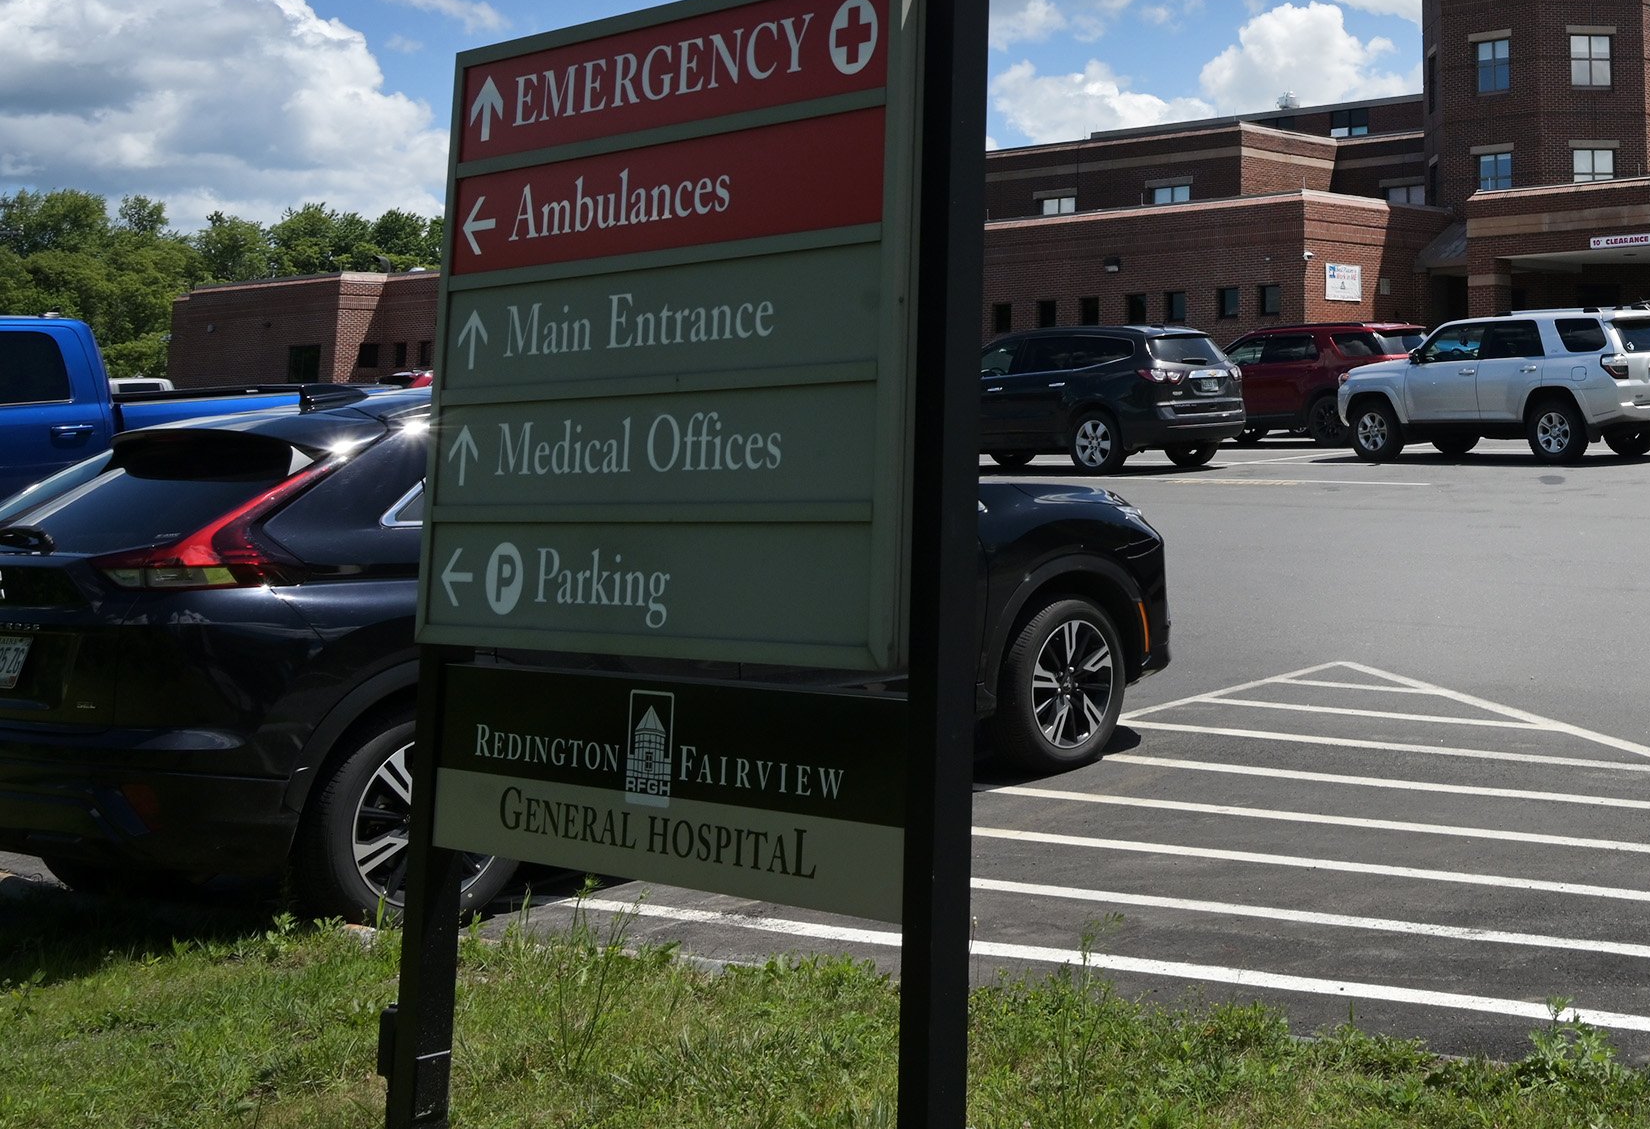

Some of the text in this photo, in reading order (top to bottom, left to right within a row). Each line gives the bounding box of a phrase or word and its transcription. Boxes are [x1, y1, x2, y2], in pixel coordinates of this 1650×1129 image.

[512, 13, 814, 127] EMERGENCY
[509, 168, 730, 241] Ambulances
[1606, 236, 1649, 245] CLEARANCE
[503, 292, 774, 358] Main Entrance
[494, 411, 782, 476] Medical Offices
[534, 547, 671, 629] Parking
[475, 723, 845, 800] REDINGTON FAIRVIEW
[625, 776, 671, 797] RFGH
[500, 786, 817, 880] GENERAL HOSPITAL
